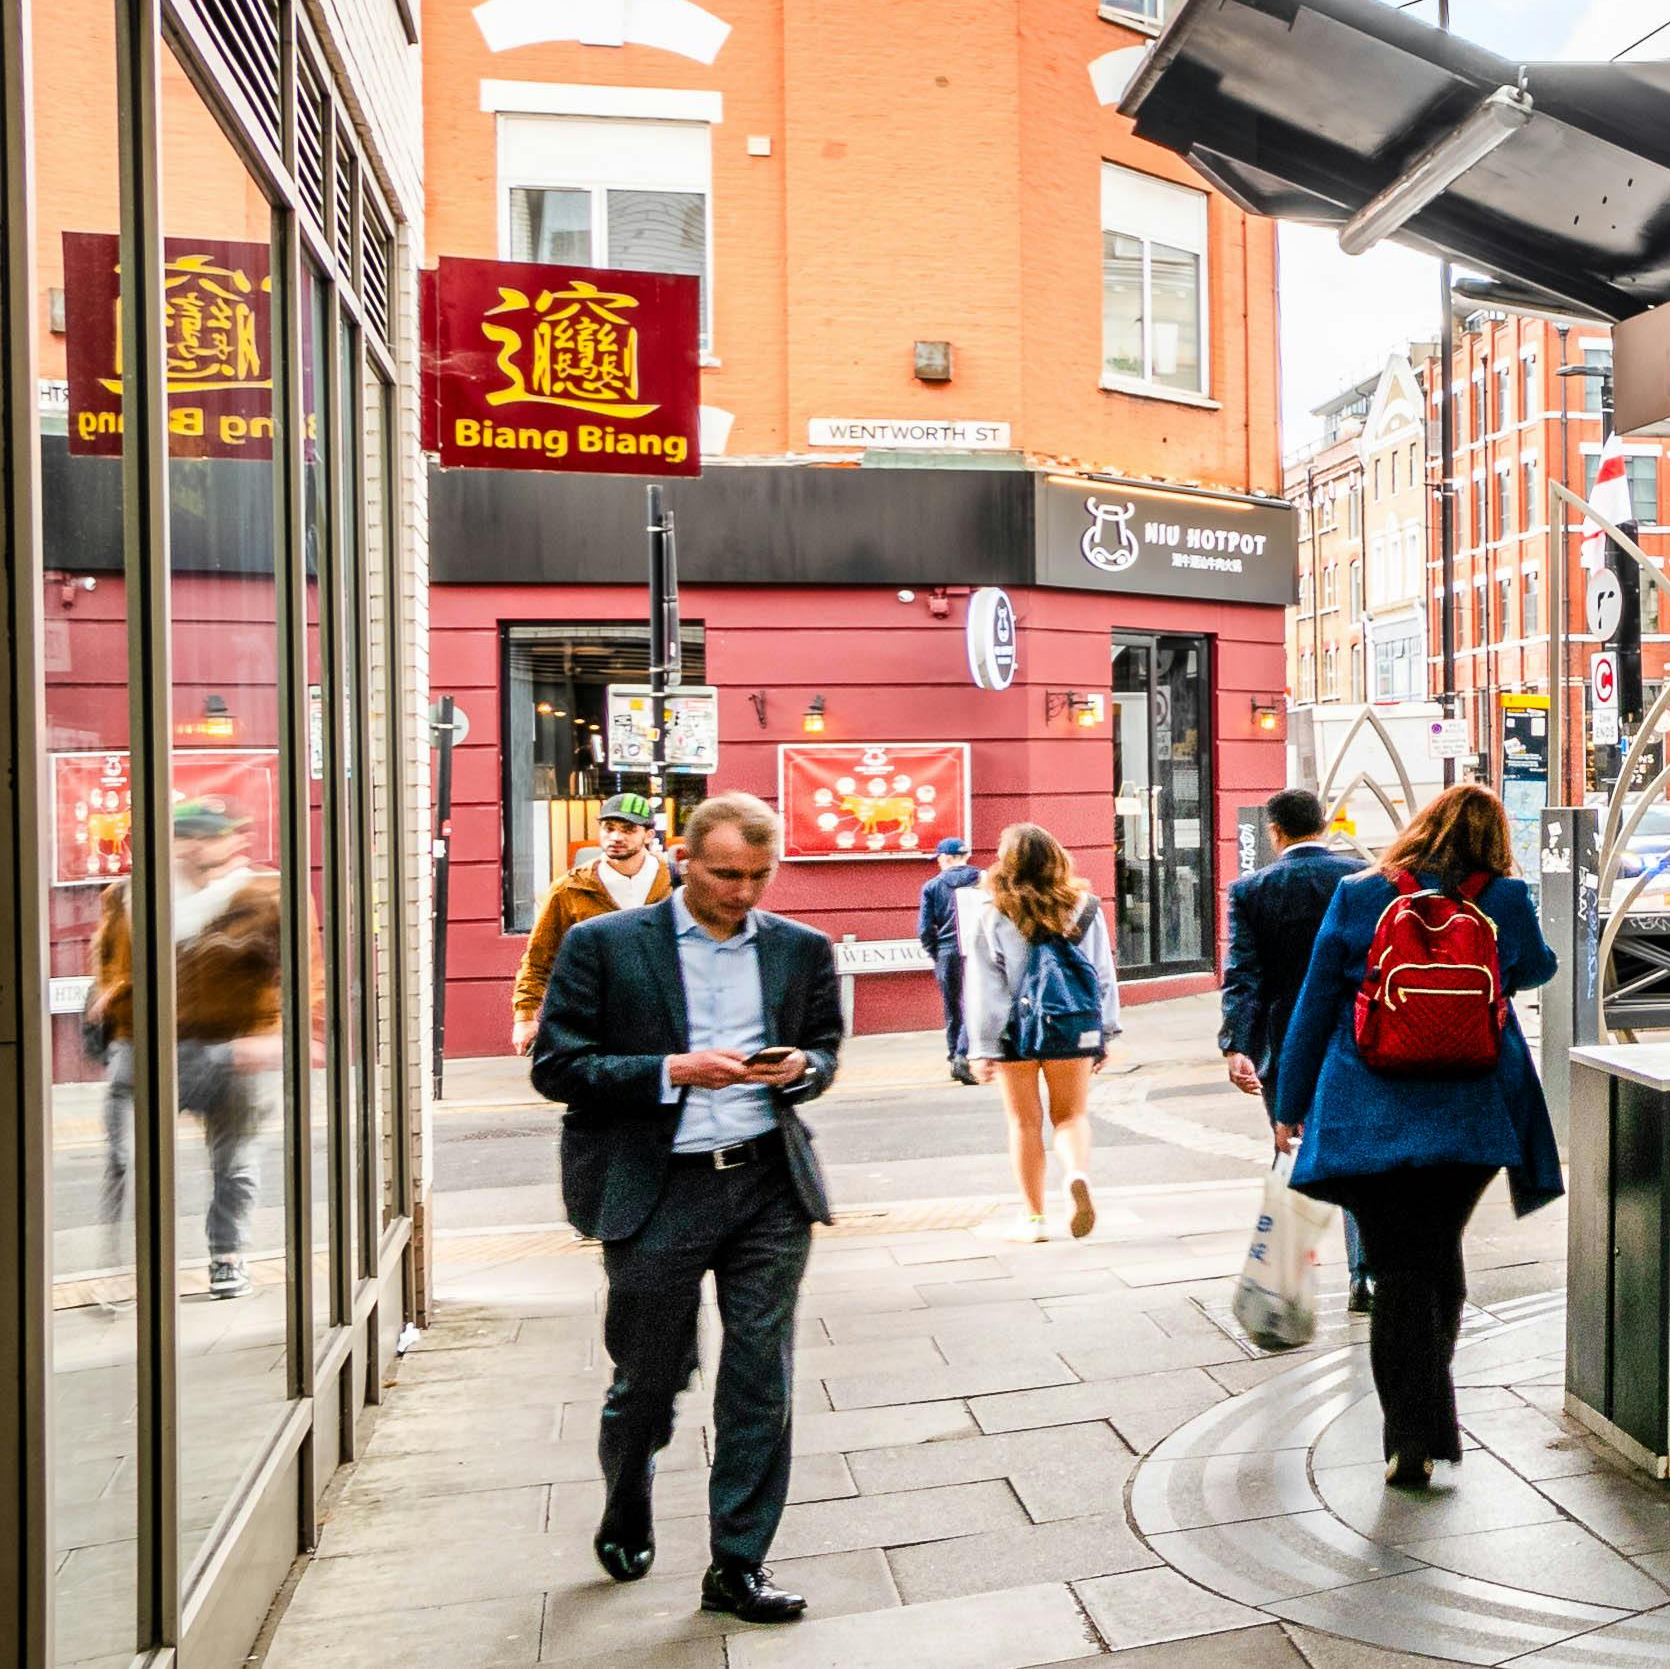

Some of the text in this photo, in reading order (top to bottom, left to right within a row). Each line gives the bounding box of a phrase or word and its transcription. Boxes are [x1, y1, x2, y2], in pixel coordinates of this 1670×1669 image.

[454, 418, 688, 463] Biang Biang
[829, 425, 1000, 442] WENTWORTH ST
[1144, 522, 1267, 555] NIU HOTPOT
